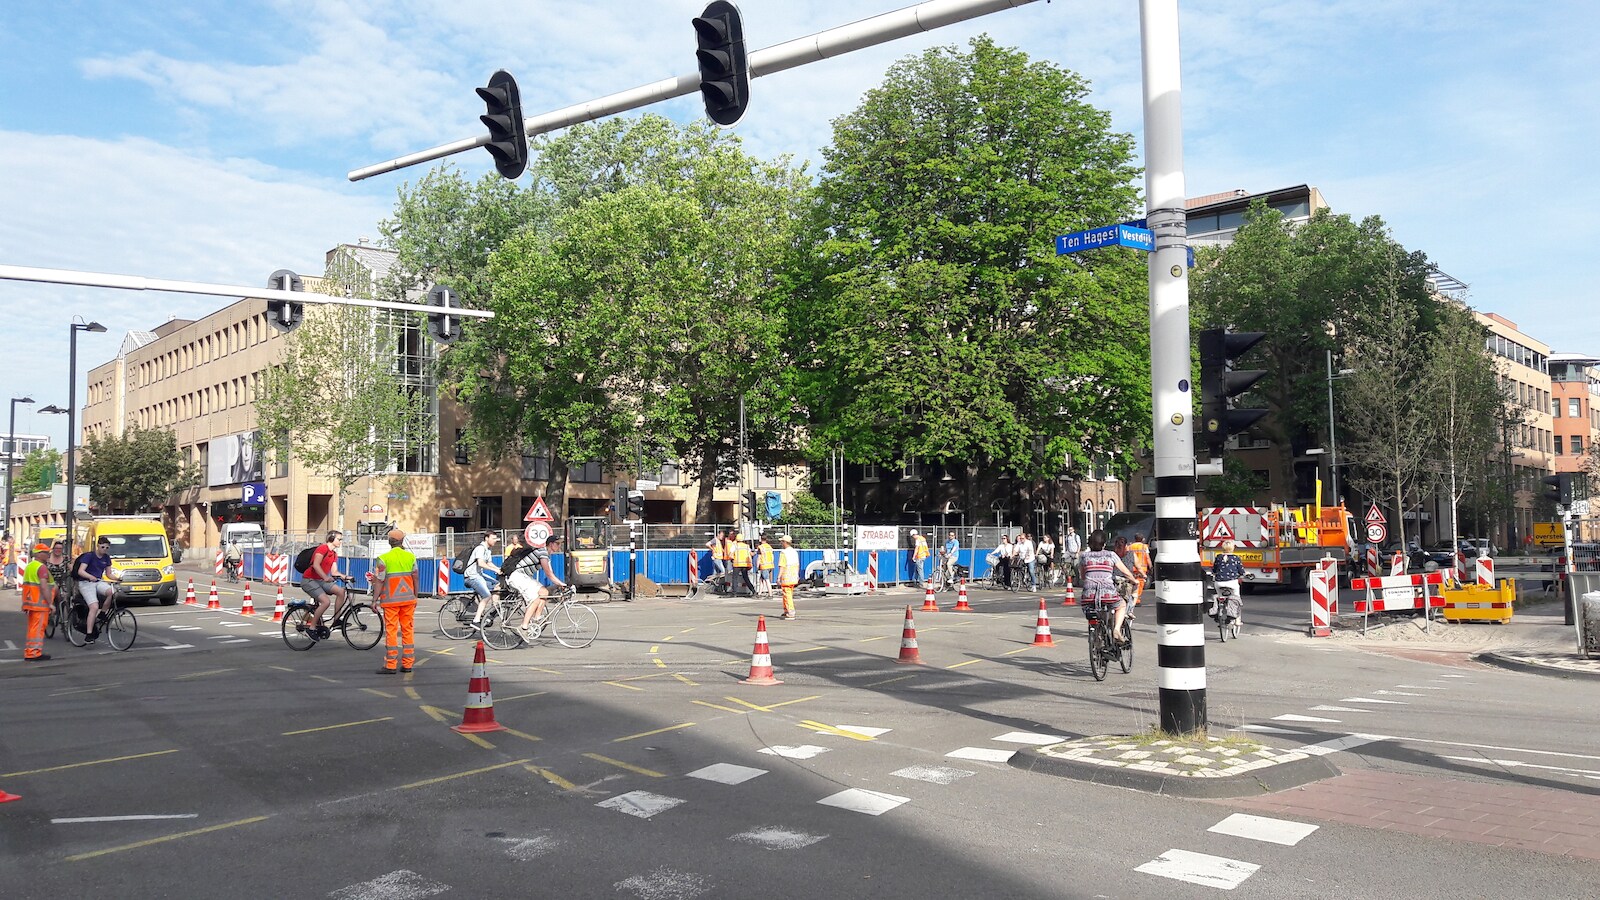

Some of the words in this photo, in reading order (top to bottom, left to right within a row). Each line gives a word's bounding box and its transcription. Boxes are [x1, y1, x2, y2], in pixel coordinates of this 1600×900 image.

[1062, 236, 1080, 249] Ten
[1122, 229, 1153, 246] Vestdijk
[244, 487, 254, 502] P
[530, 528, 548, 540] 30
[861, 530, 895, 540] STRABAG
[1368, 528, 1382, 537] 30
